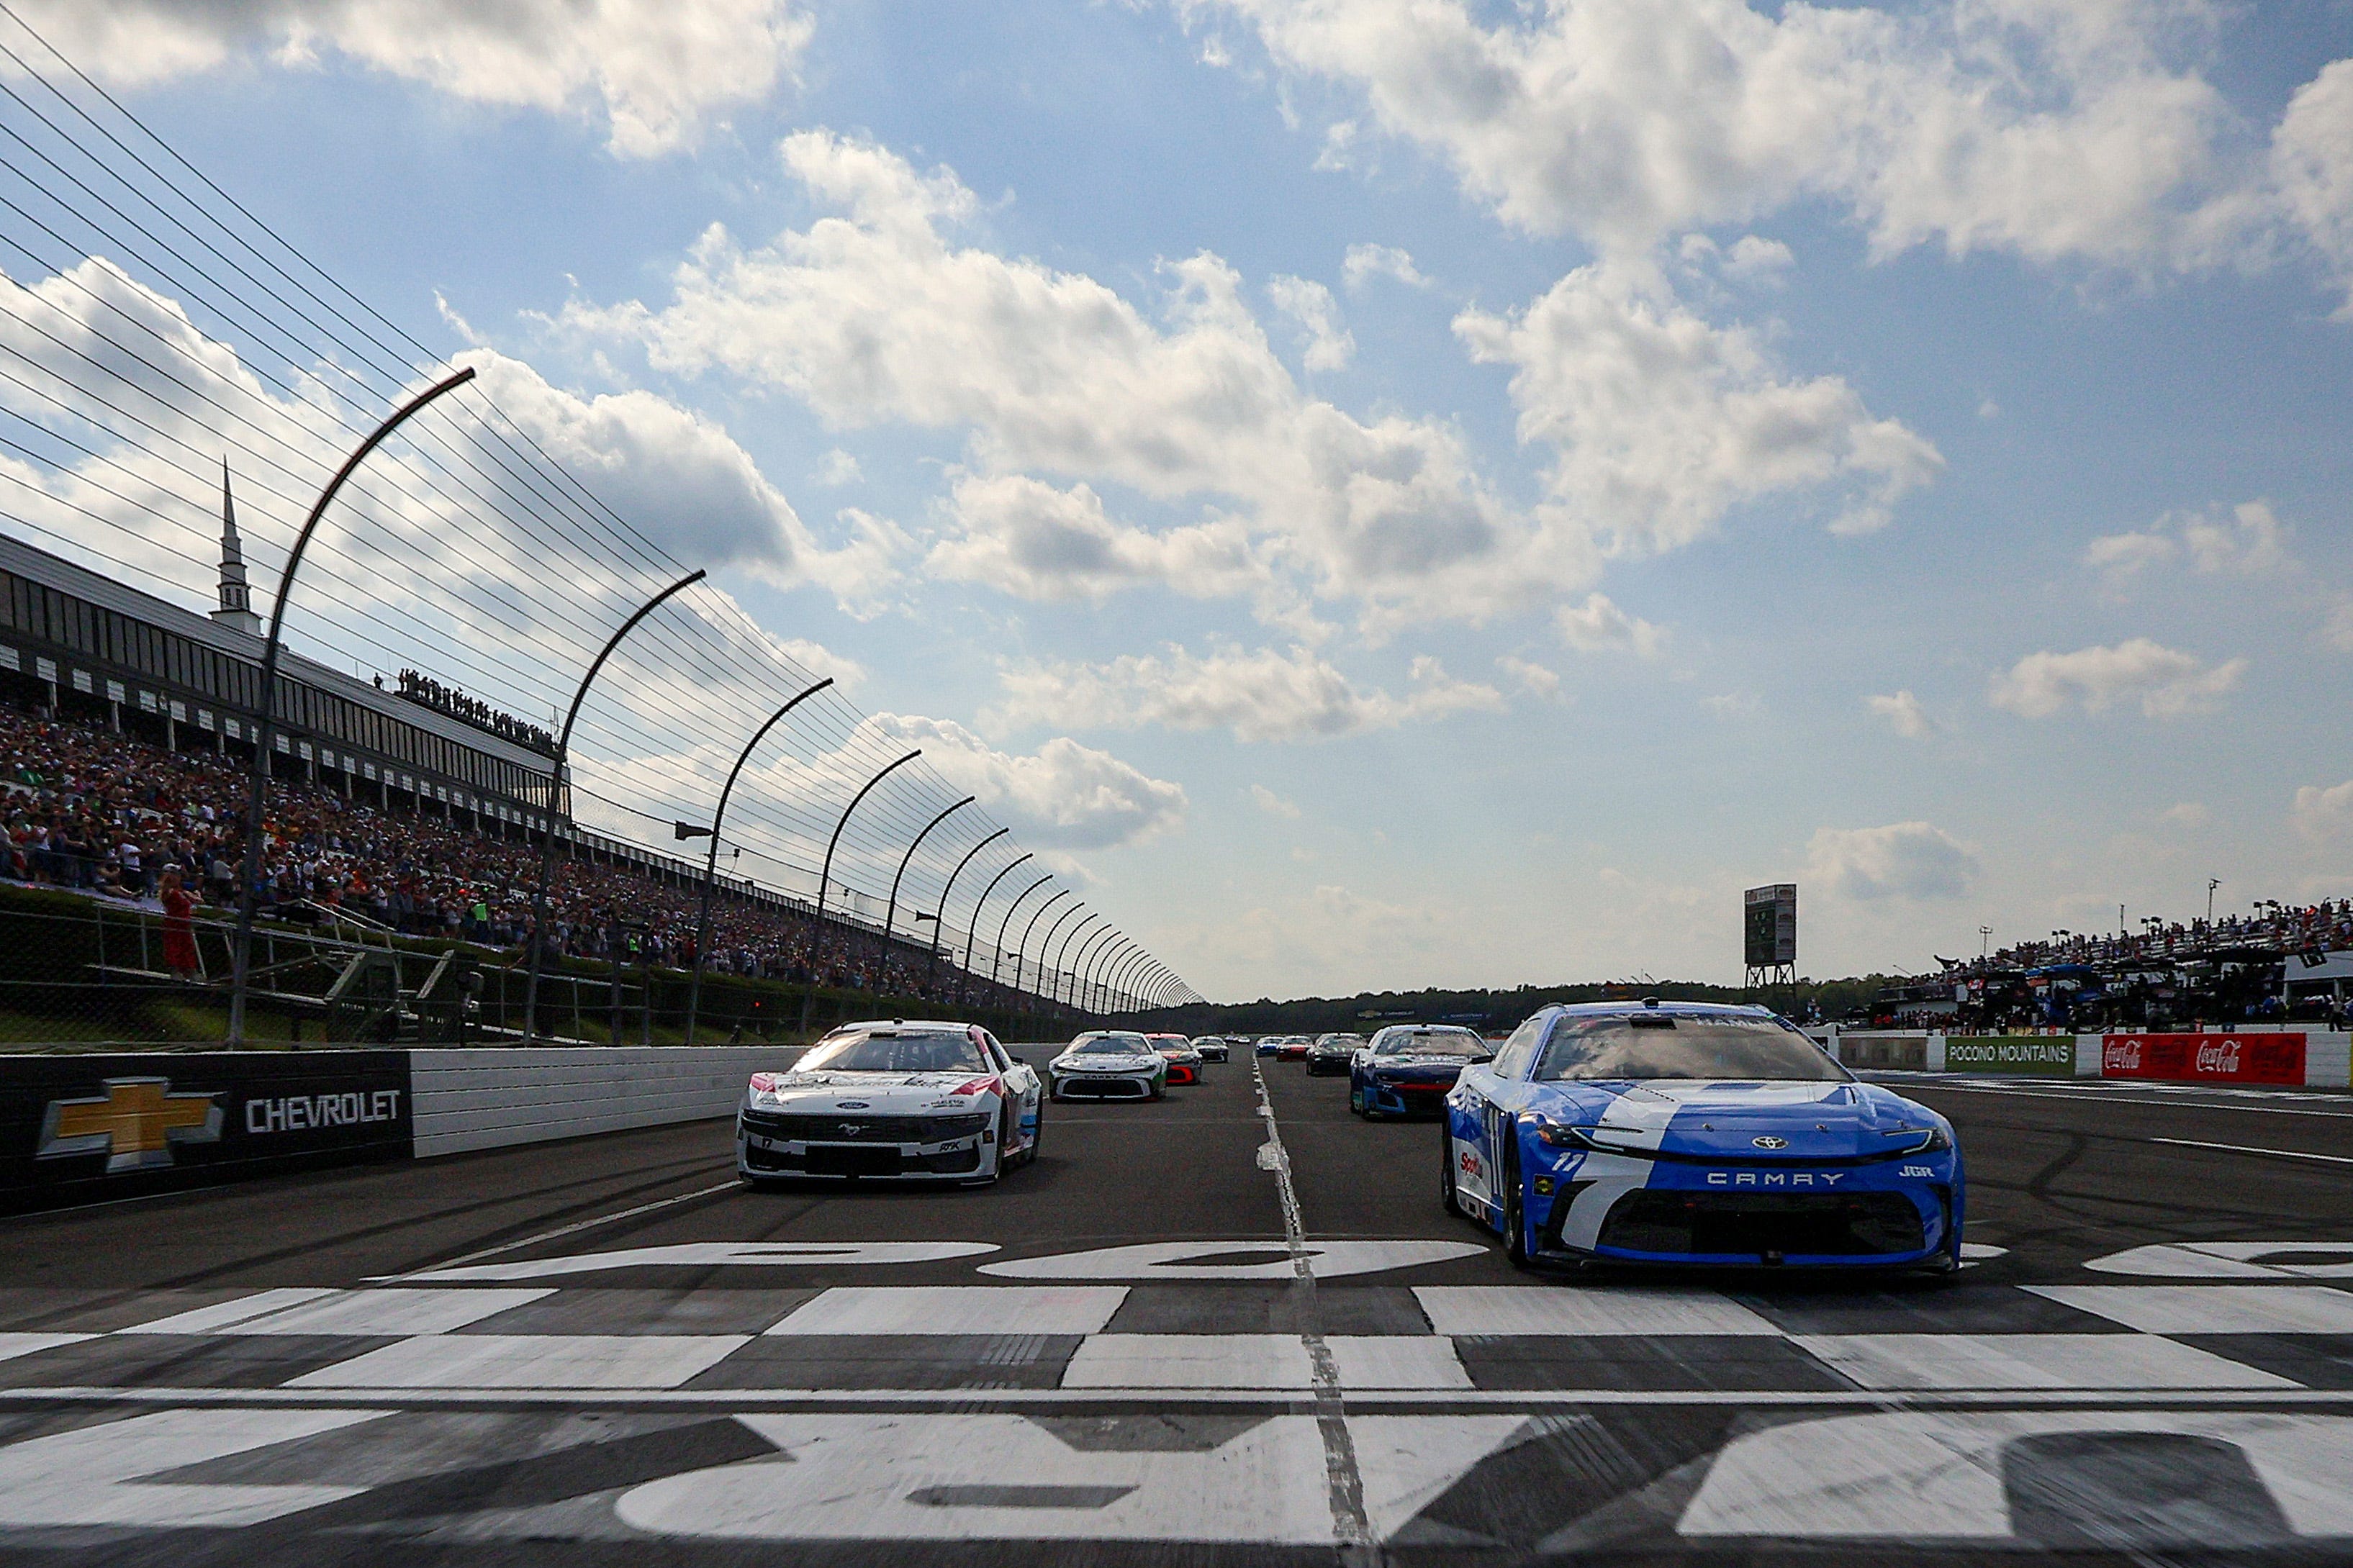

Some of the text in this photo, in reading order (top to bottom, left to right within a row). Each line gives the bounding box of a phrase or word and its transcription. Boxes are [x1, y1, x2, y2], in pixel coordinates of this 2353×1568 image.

[1949, 1045, 2069, 1063] POCONO MOUNTAINS
[245, 1090, 401, 1133] CHEVROLET
[1551, 1151, 1584, 1172] 11
[1898, 1165, 1936, 1177] JGR
